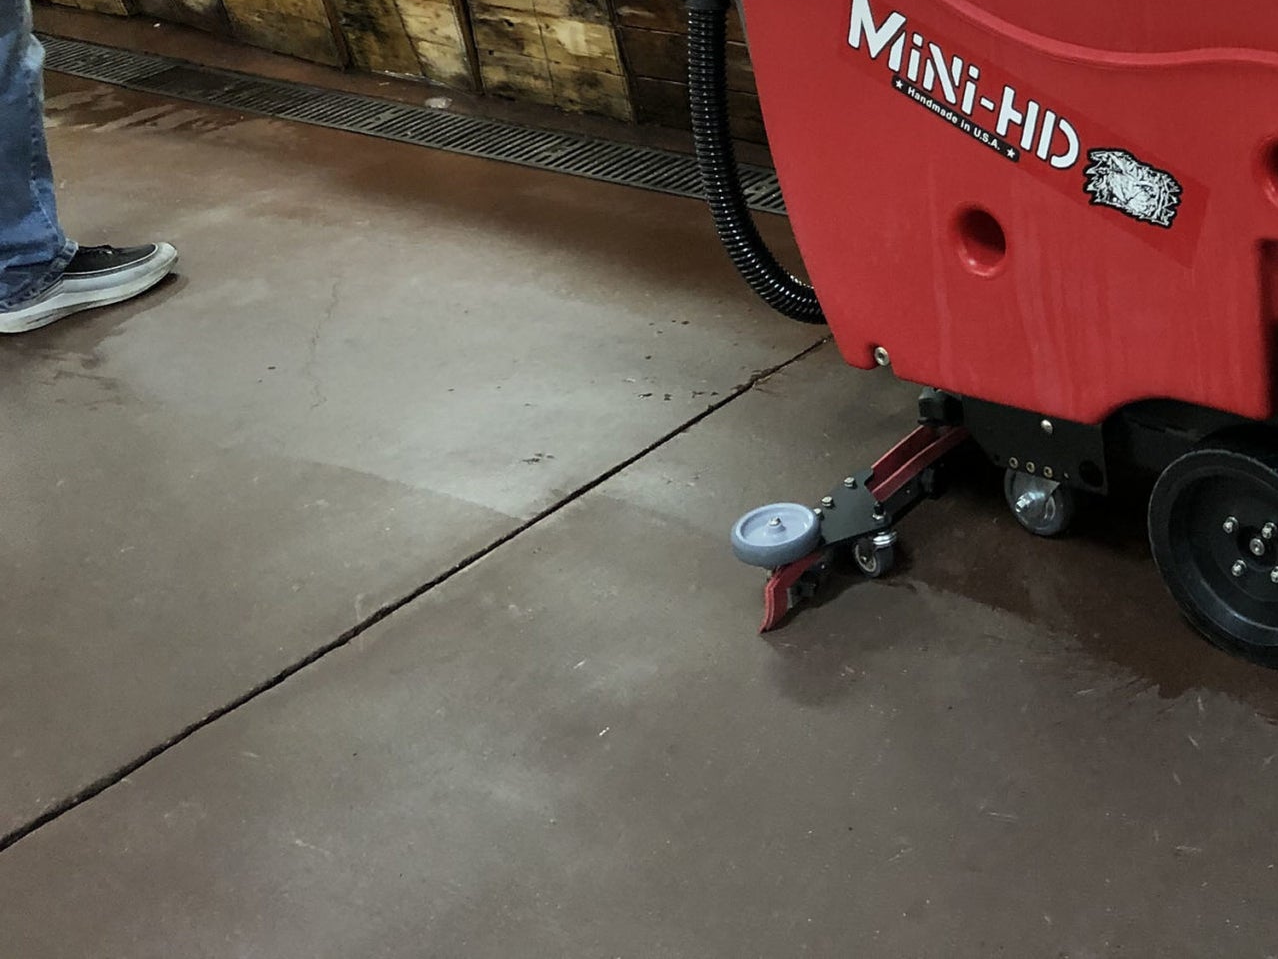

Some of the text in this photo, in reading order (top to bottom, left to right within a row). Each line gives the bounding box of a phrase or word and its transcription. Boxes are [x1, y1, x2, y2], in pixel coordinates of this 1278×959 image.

[907, 86, 1001, 151] Handmade in U.S.A.
